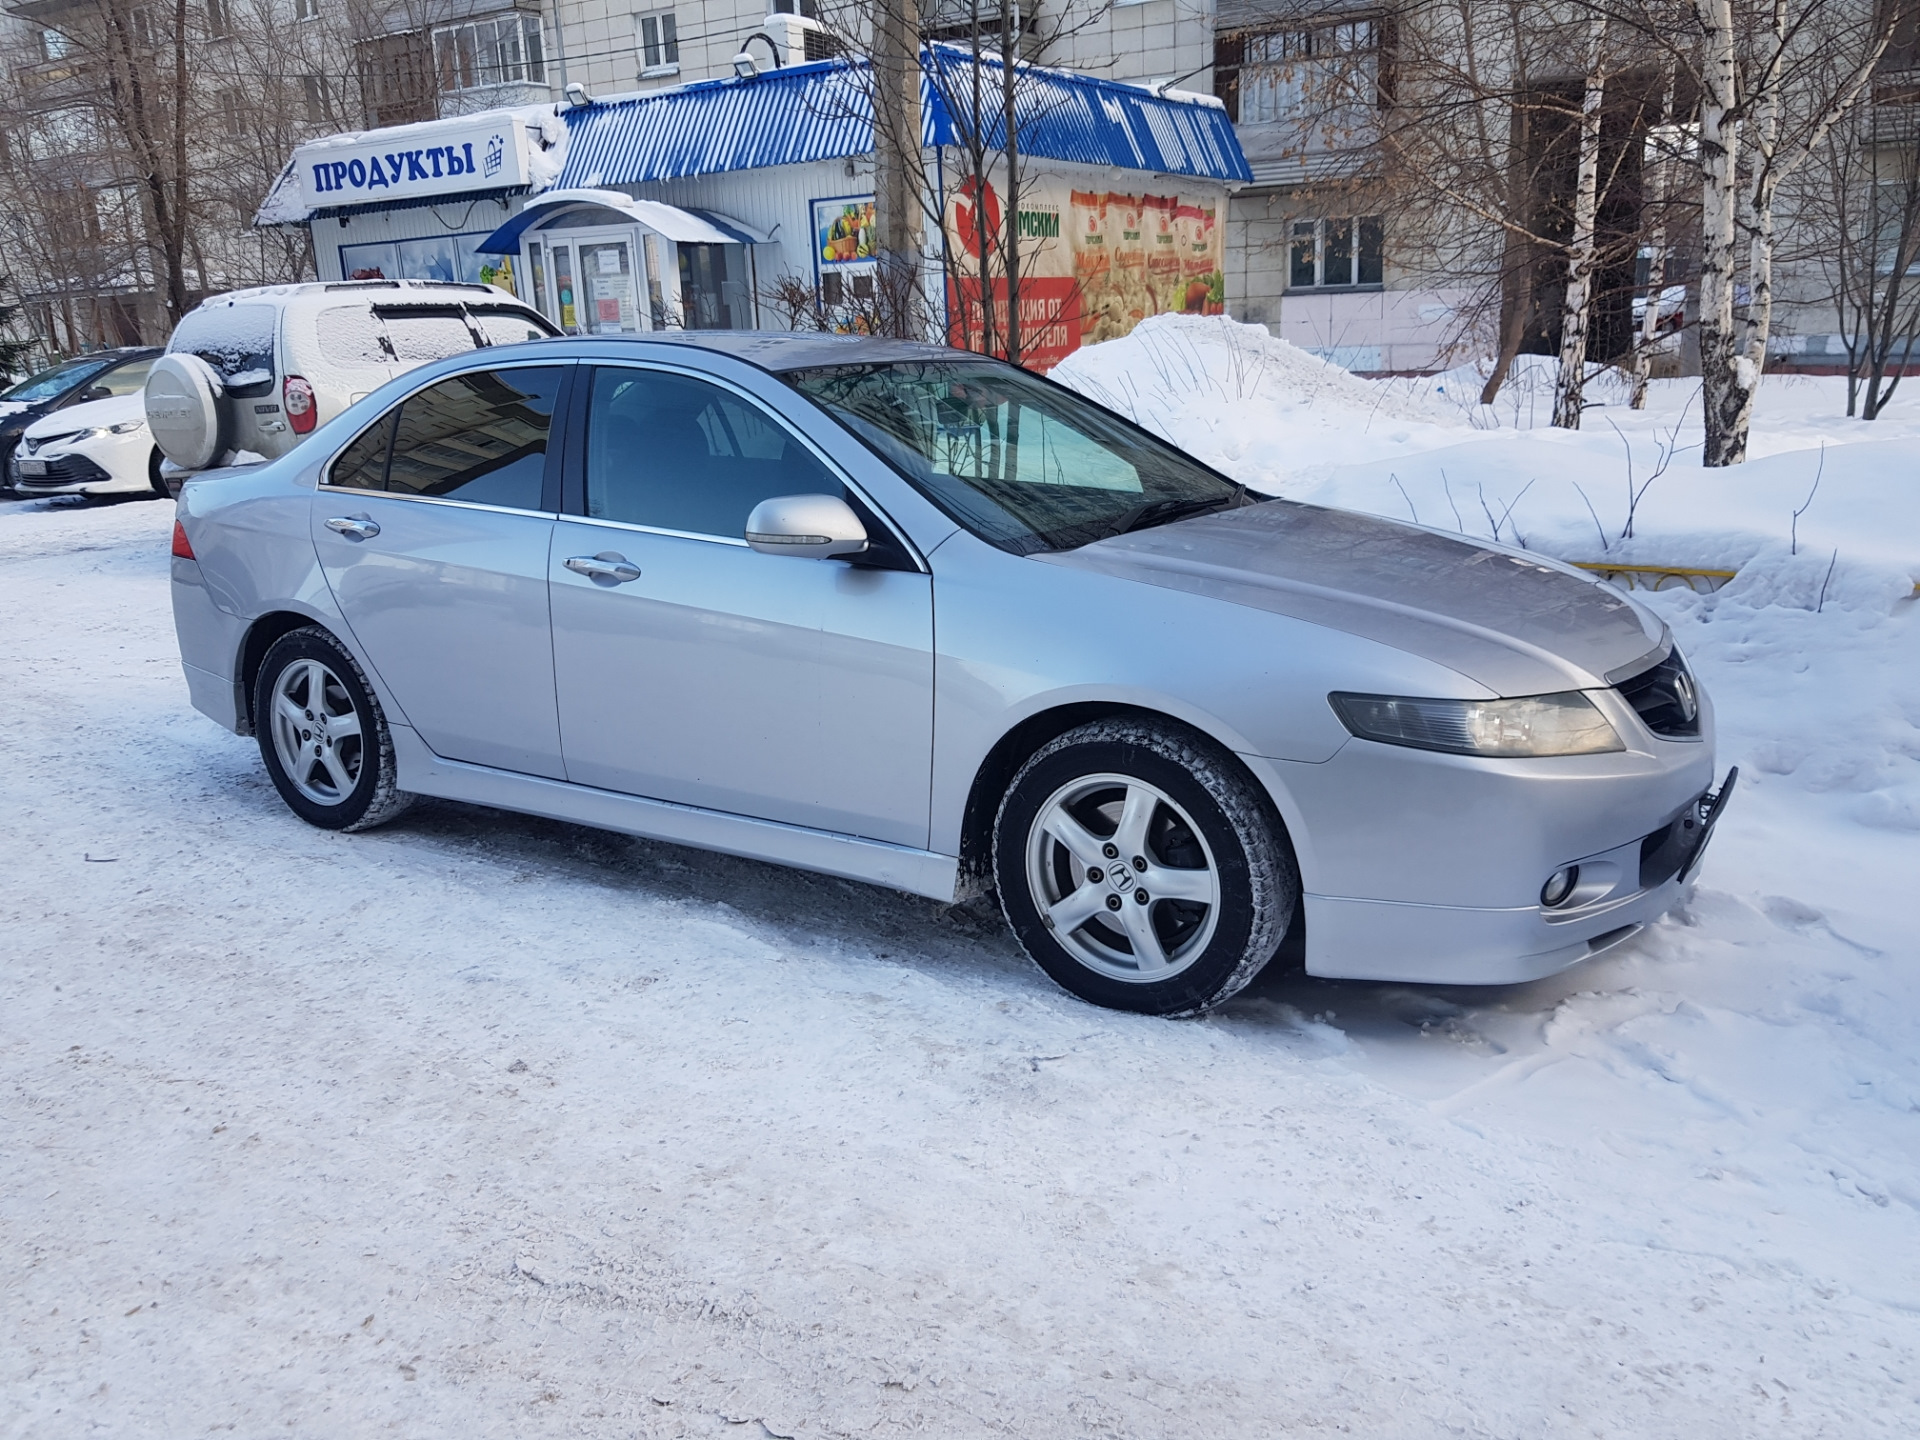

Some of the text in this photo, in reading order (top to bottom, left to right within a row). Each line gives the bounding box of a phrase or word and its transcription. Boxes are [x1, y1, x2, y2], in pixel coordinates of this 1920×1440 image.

[312, 142, 476, 192] ПРОДУКТЫ
[1004, 202, 1060, 212] ОКОМПЛЕКС
[1004, 210, 1060, 238] МСКИЙ
[971, 298, 1062, 326] ПДЦИЯ ОТ
[968, 325, 1068, 357] ПРИЗДИТЕЛЯ
